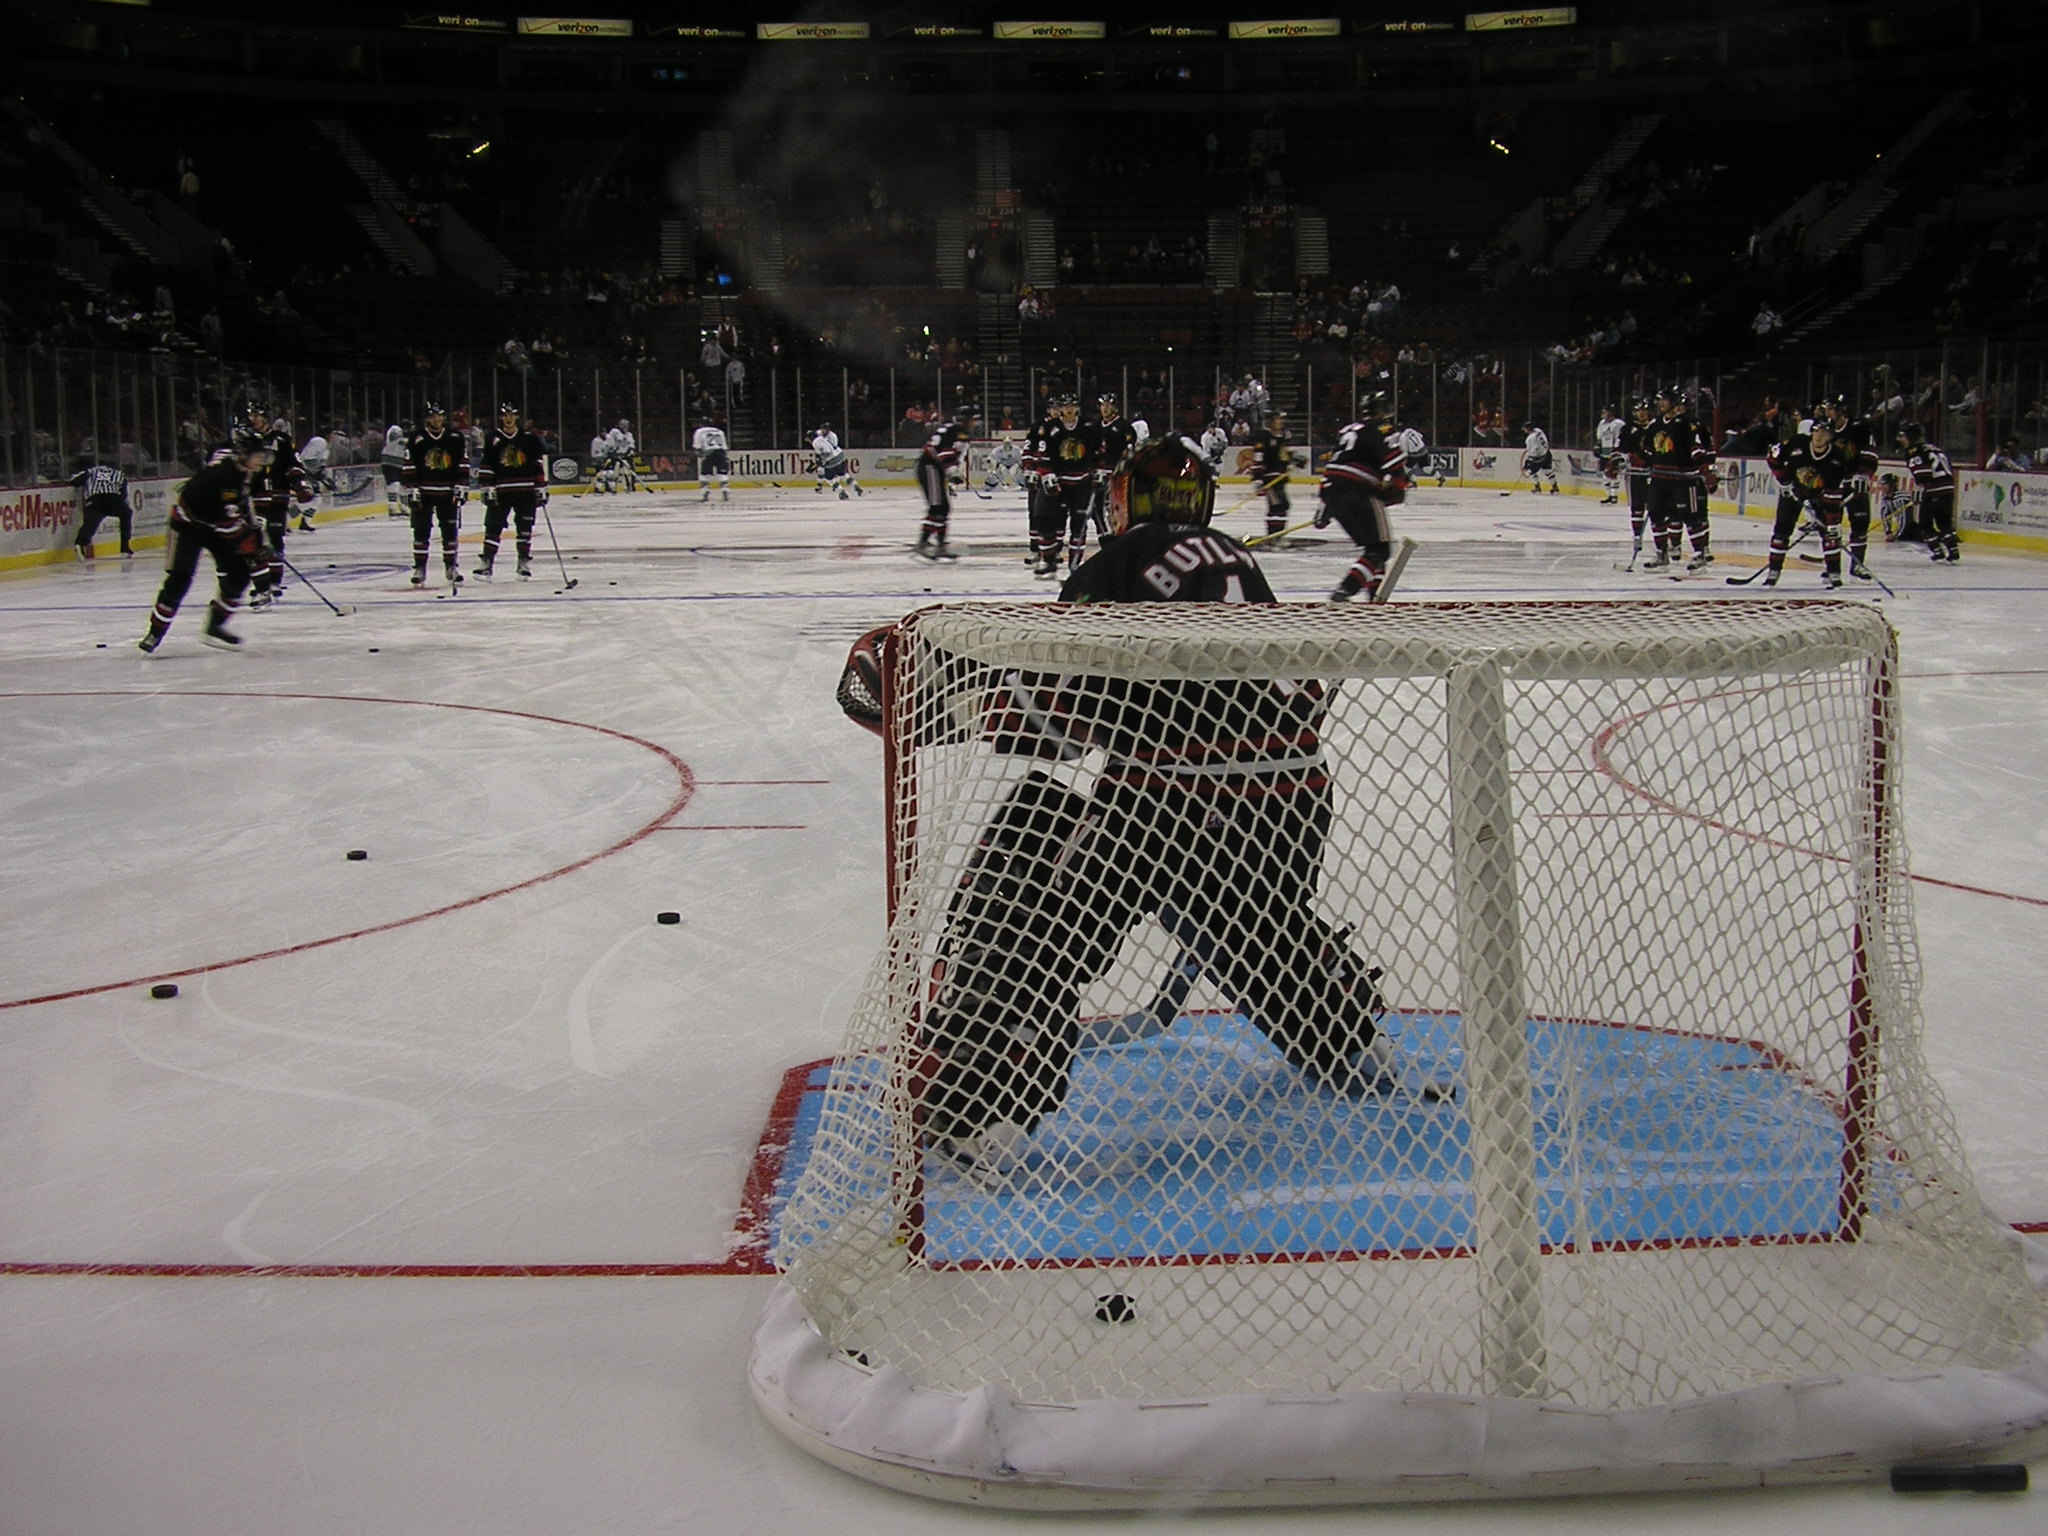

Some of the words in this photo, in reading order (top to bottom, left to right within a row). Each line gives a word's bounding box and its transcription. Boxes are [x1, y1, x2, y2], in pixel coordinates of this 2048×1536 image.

[1503, 13, 1544, 27] verizon
[558, 21, 599, 33] verizon
[796, 26, 837, 38] verizon
[1032, 25, 1073, 37] verizon
[1267, 23, 1308, 36] verizon
[729, 453, 785, 476] rtland
[787, 452, 860, 475] Trie
